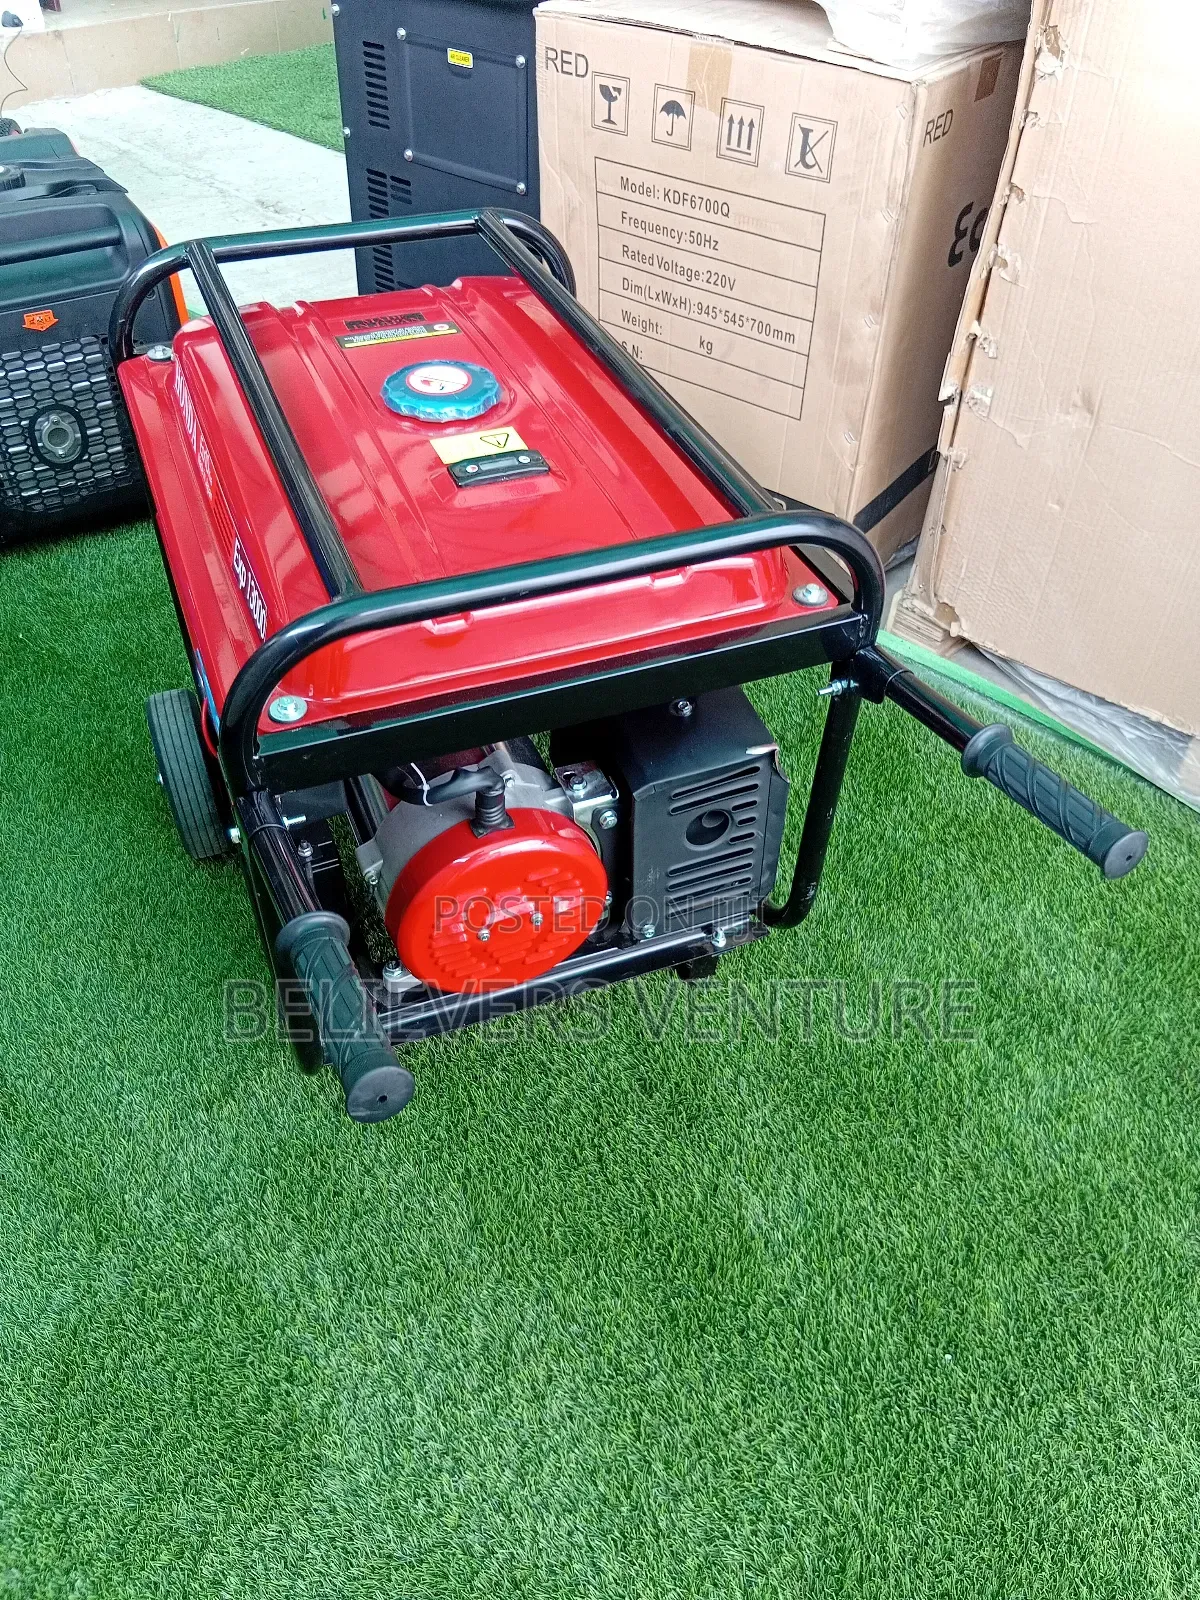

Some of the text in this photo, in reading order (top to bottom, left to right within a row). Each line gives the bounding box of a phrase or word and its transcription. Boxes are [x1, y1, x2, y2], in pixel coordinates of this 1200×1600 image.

[545, 46, 589, 79] RED
[923, 109, 954, 148] RED
[620, 176, 730, 218] Model: KDF6700Q
[621, 211, 719, 251] Frequency:50Hz
[622, 244, 736, 290] Rated Voltage:220V
[621, 309, 713, 355] Weight: kg
[173, 355, 197, 453] HONDA
[233, 537, 247, 589] Exp
